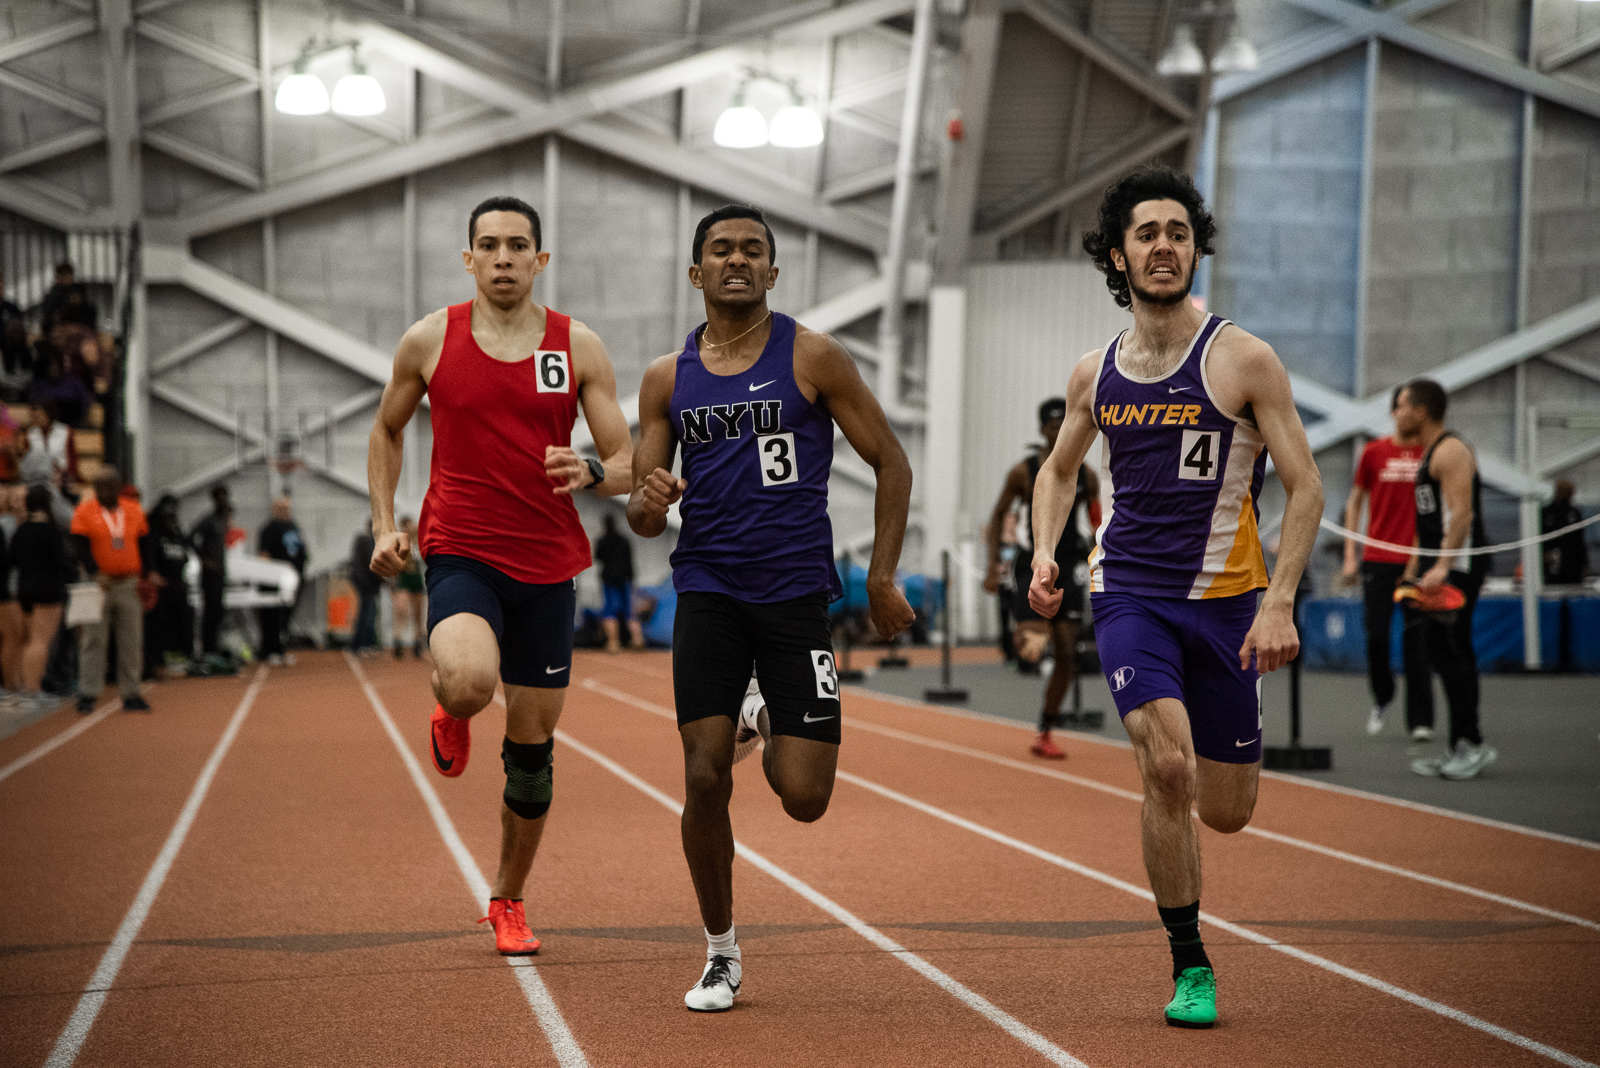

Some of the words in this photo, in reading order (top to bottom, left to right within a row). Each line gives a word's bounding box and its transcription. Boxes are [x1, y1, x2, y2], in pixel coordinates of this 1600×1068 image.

[540, 353, 566, 389] 6
[681, 400, 782, 443] NYU
[1100, 404, 1202, 426] HUNTER
[764, 438, 793, 482] 3
[1183, 434, 1213, 477] 4
[817, 653, 838, 696] 3
